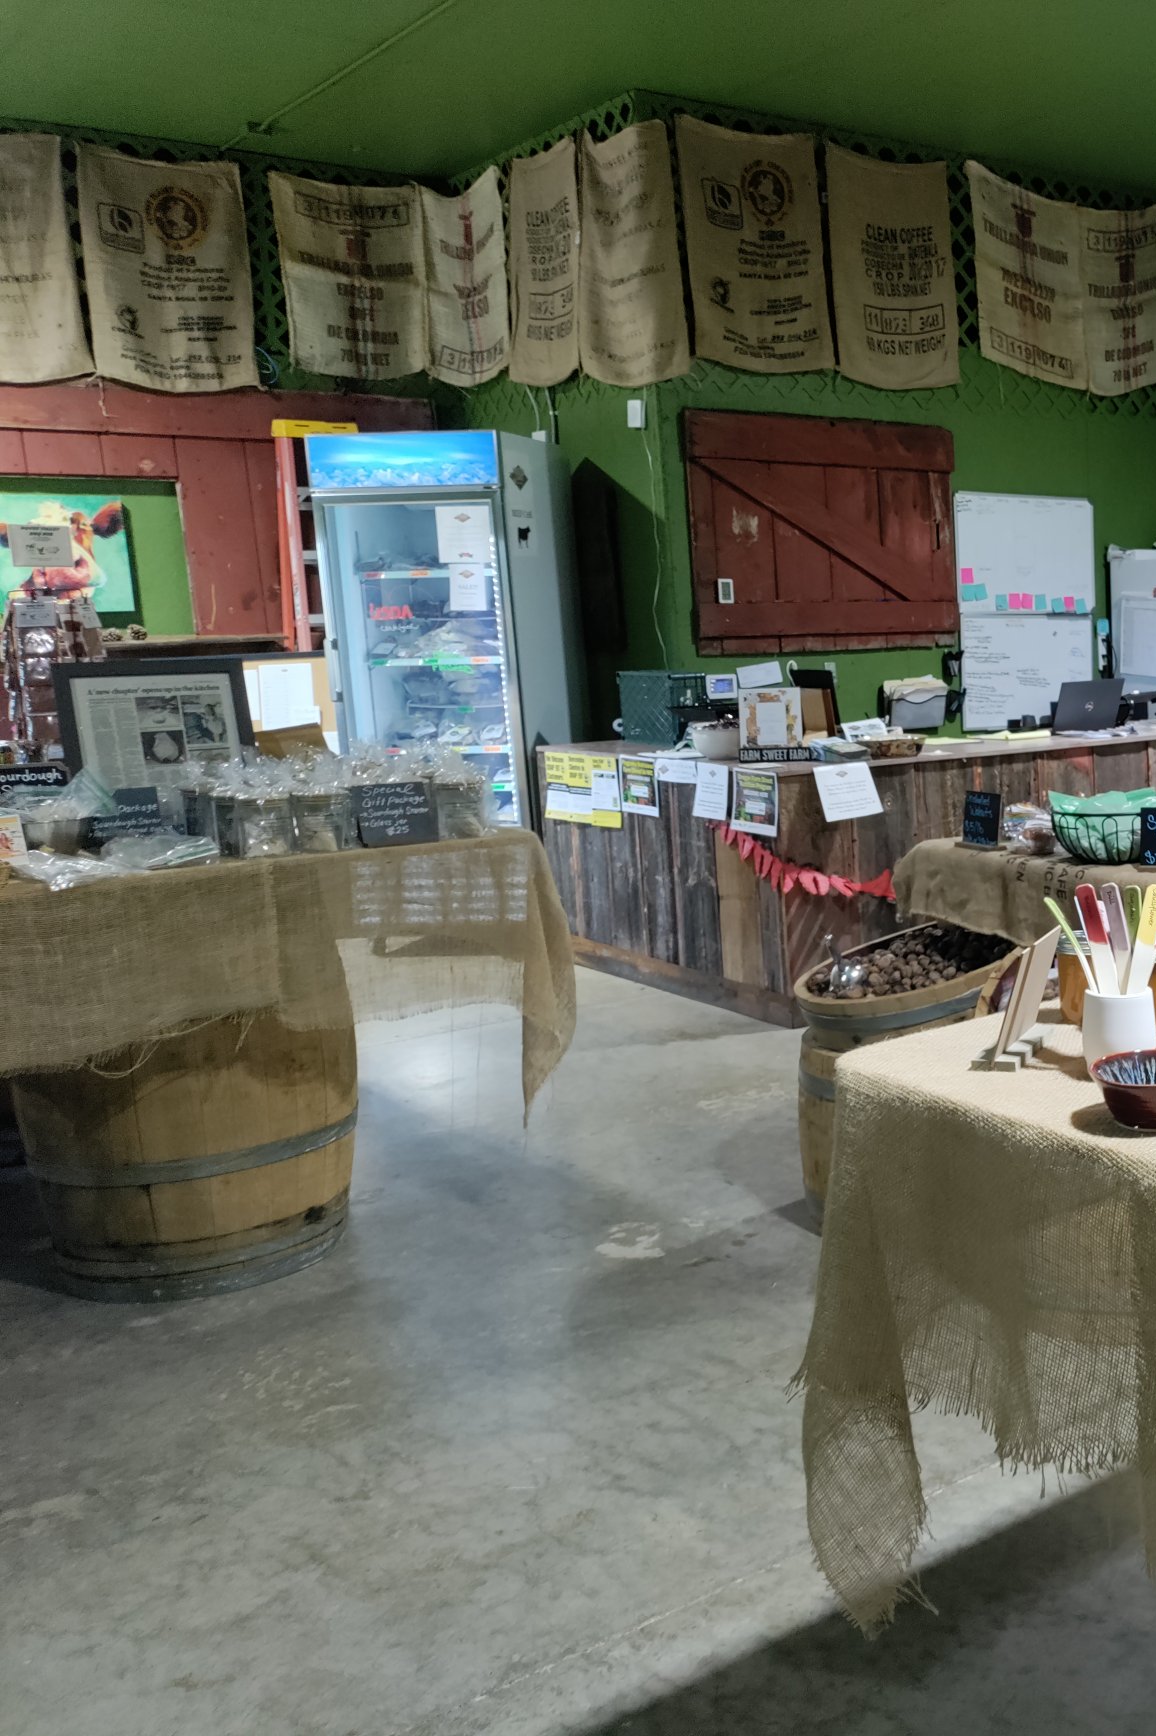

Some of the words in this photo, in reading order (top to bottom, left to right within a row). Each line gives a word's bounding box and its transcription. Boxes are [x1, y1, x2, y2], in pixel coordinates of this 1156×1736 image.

[865, 223, 897, 244] CLEAN
[899, 225, 934, 244] COFFEE
[864, 258, 904, 270] COSECHA
[865, 268, 904, 281] CROP
[876, 339, 897, 355] KGS
[898, 339, 914, 355] NET
[914, 334, 946, 354] WEIGHT
[740, 750, 761, 762] FARM
[762, 749, 787, 761] SWEET
[789, 748, 810, 760] FARM
[0, 767, 63, 784] ourdough
[362, 783, 415, 798] Special
